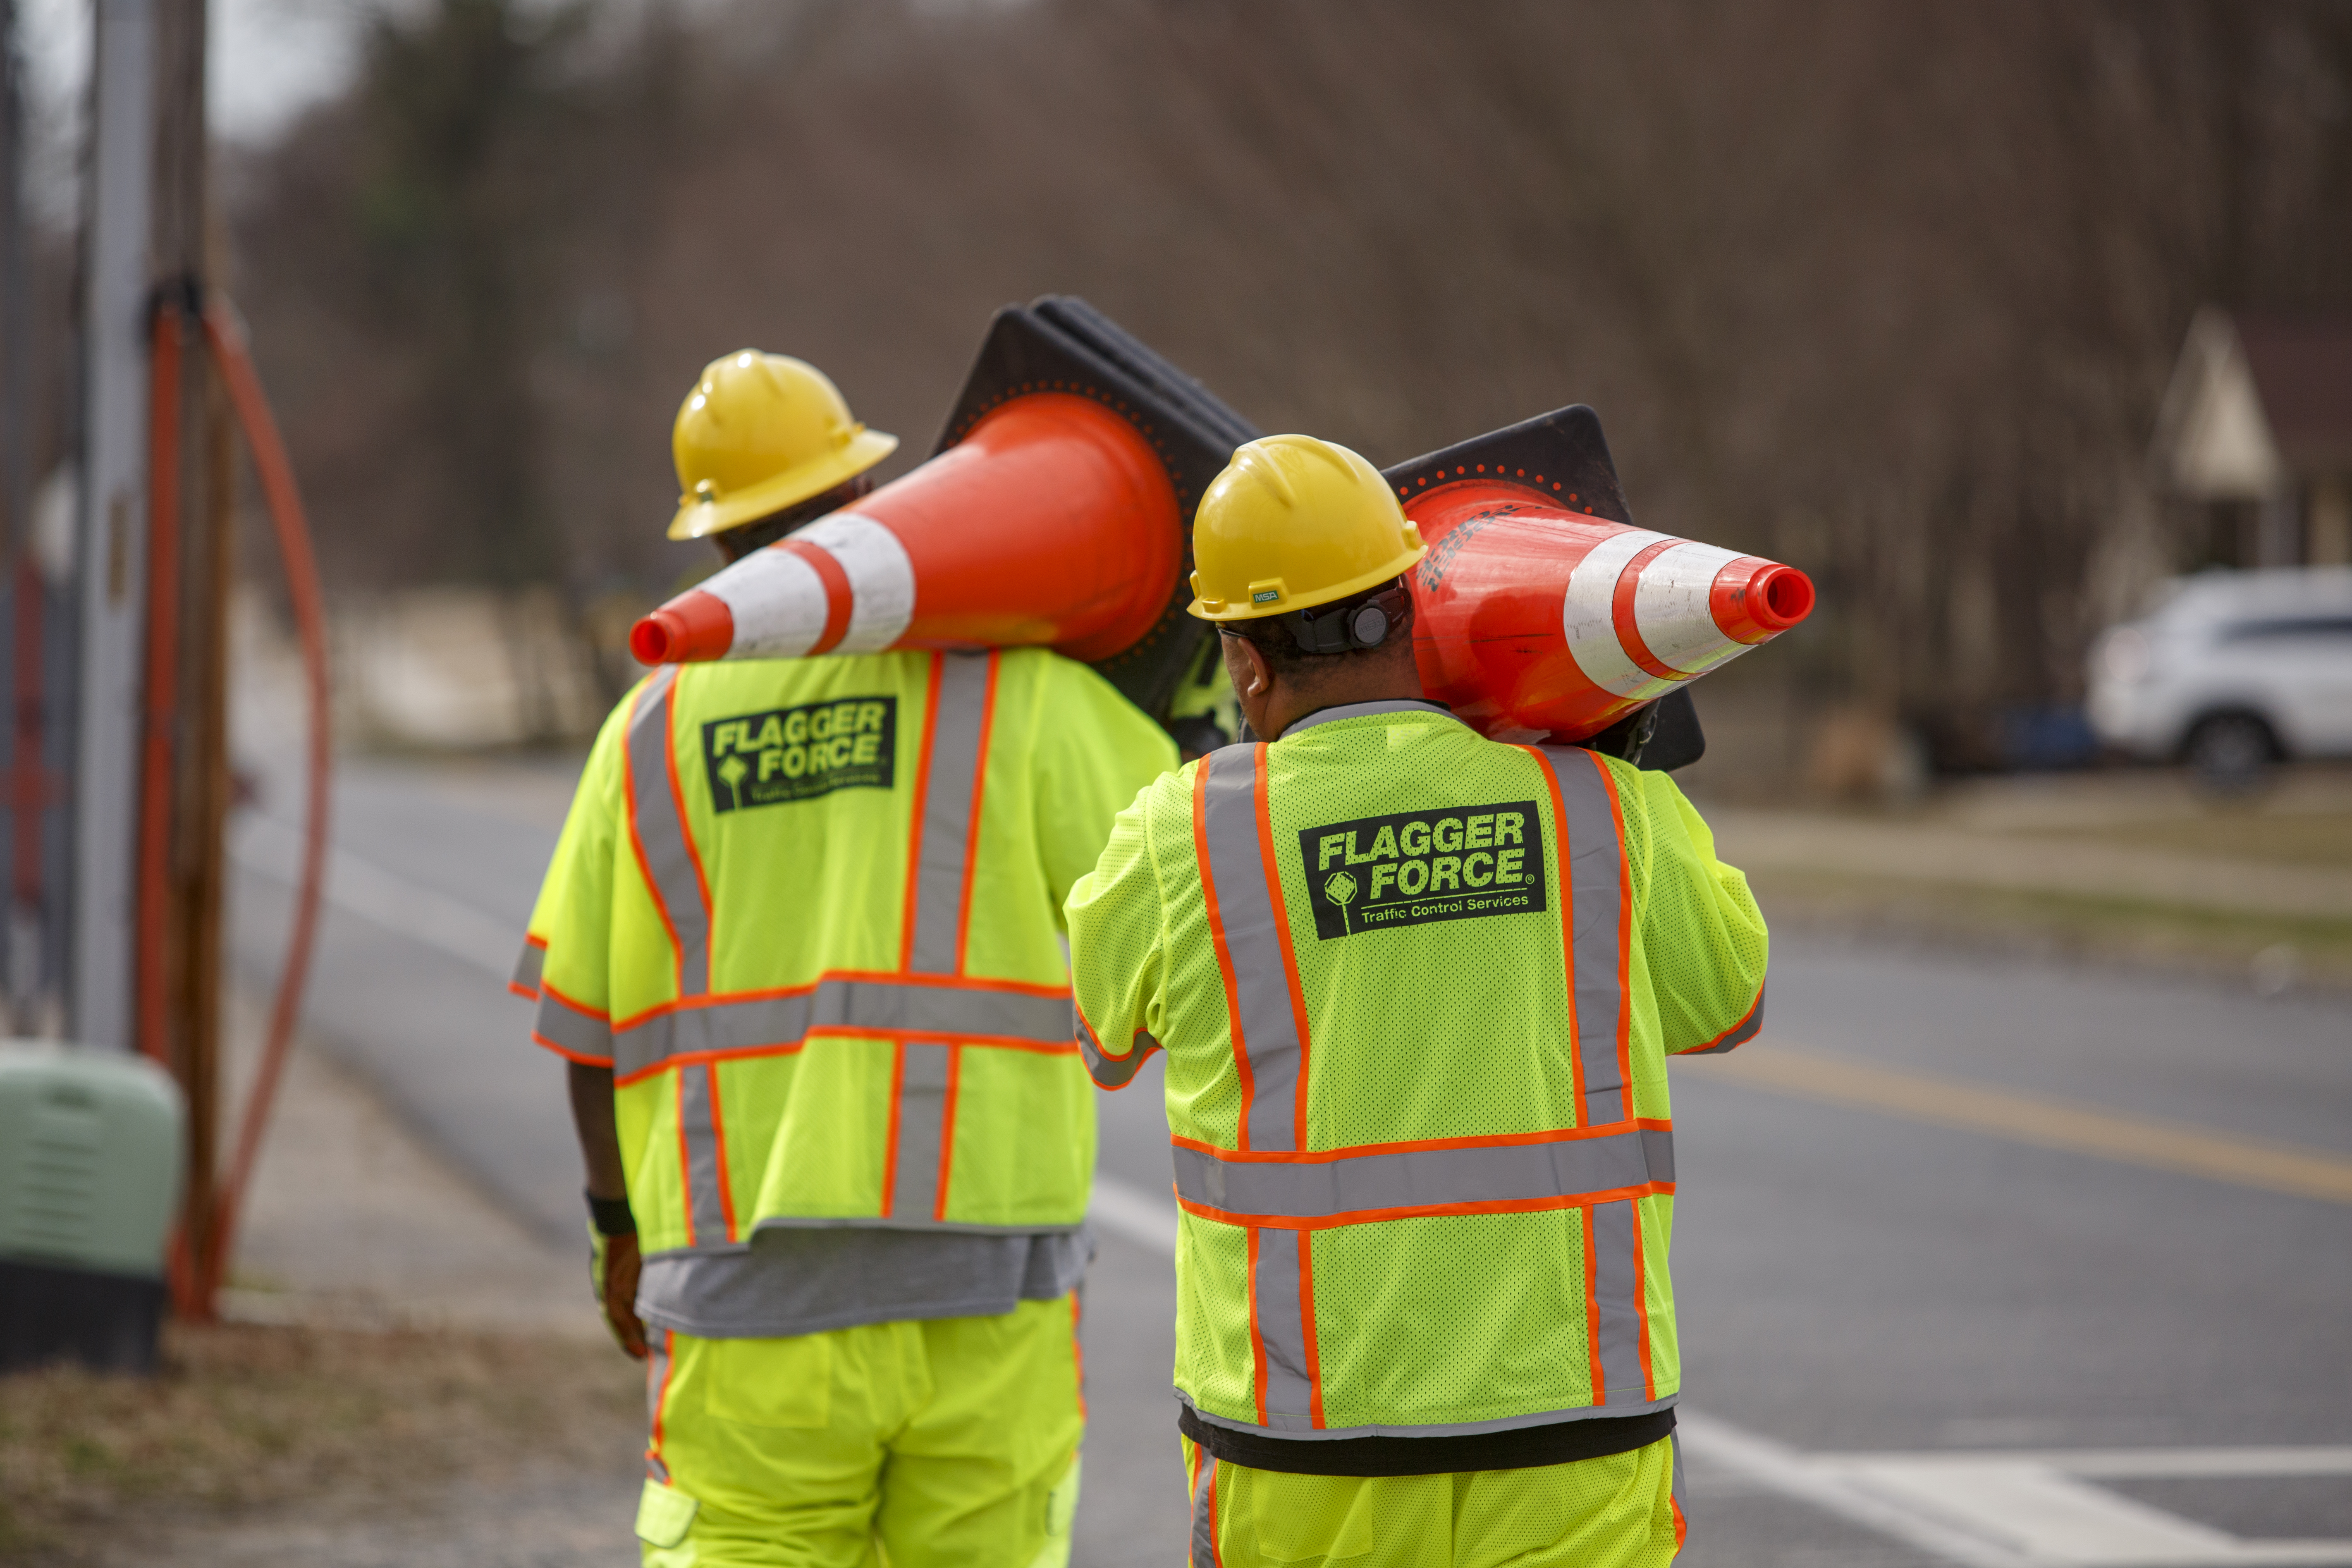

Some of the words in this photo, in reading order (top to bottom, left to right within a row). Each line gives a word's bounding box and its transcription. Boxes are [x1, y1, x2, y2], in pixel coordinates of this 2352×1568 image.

[1255, 592, 1277, 602] MSA
[712, 702, 887, 758] FLAGGER
[757, 734, 882, 782] FORCE
[1318, 812, 1525, 871] FLAGGER
[1361, 908, 1406, 923] Traffic
[1411, 900, 1462, 917] Control
[1467, 896, 1529, 911] Services
